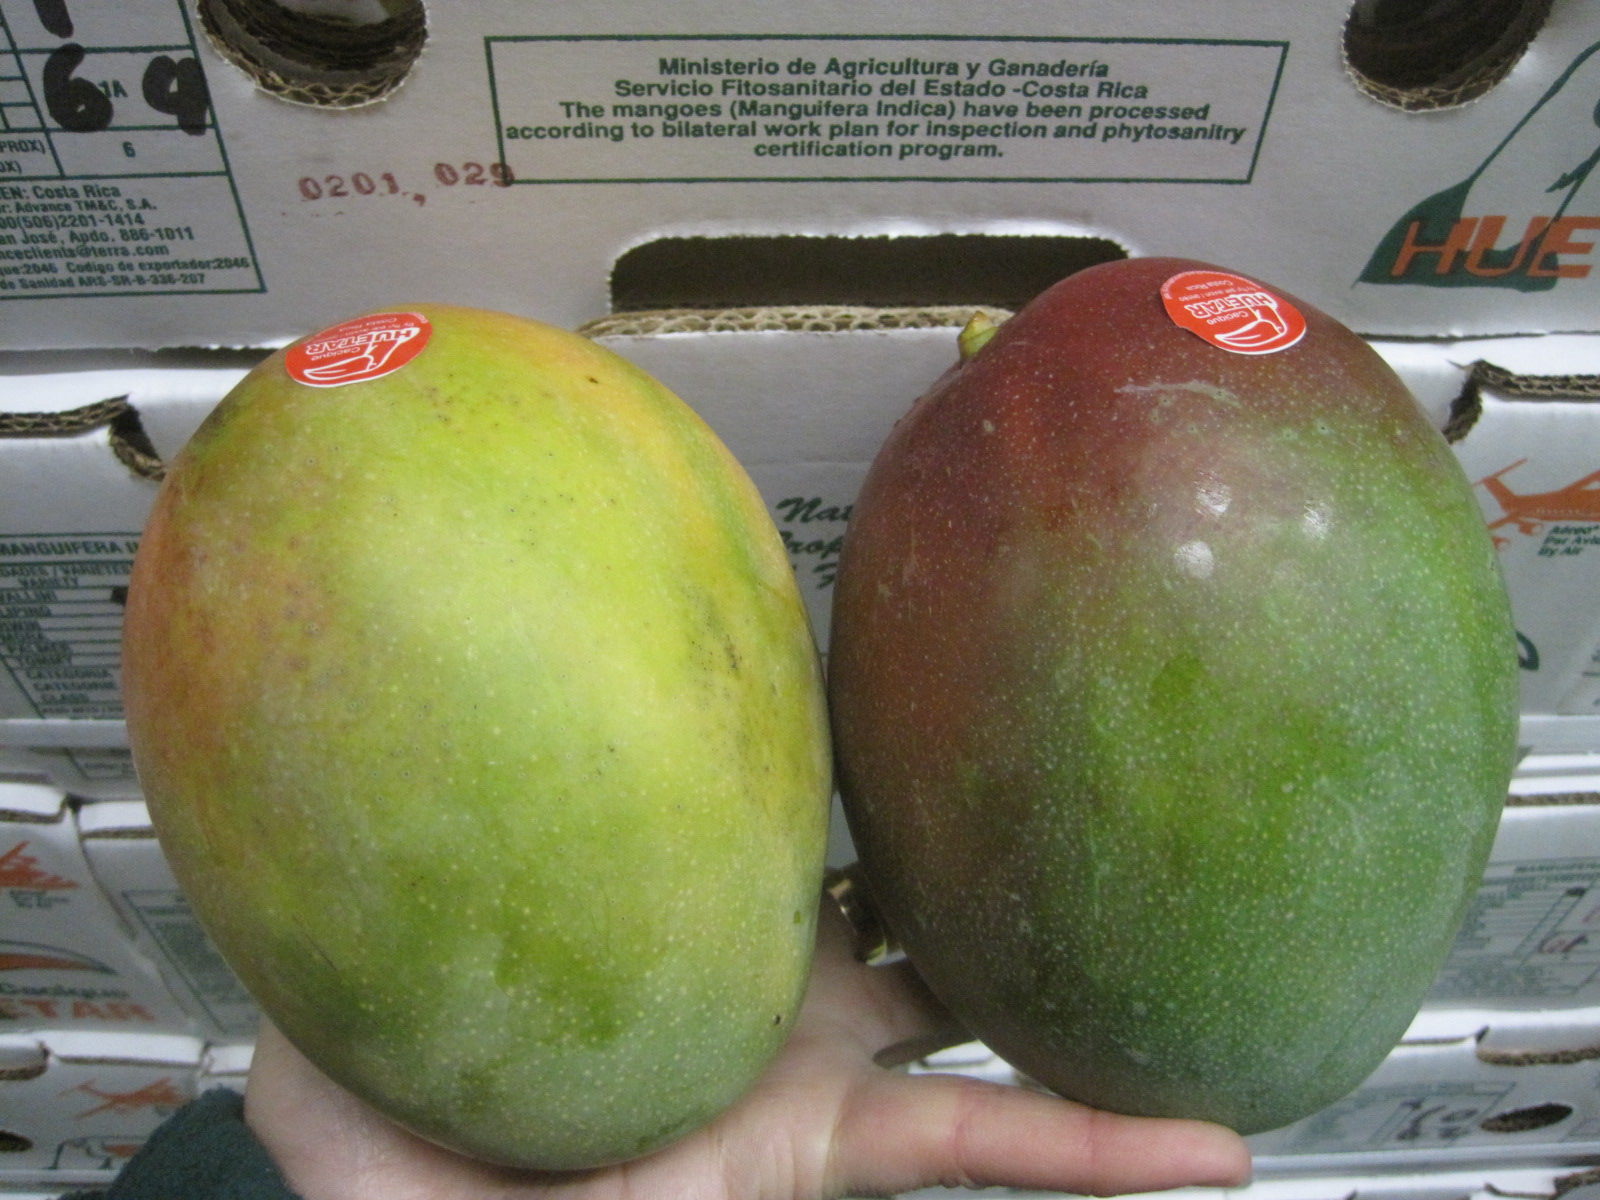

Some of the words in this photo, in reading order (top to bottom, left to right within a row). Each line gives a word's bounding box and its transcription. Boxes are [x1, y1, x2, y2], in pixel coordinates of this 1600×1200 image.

[659, 58, 779, 75] Ministerio
[787, 58, 816, 75] de
[824, 58, 959, 79] Agricultura
[967, 62, 981, 77] y
[989, 59, 1109, 77] Ganadería
[615, 80, 713, 97] Servicio
[722, 80, 872, 97] Fitosanitario
[880, 80, 915, 96] del
[924, 80, 1006, 97] Estado
[1097, 82, 1149, 99] Rica
[560, 101, 605, 118] The
[613, 105, 722, 122] mangoes
[729, 100, 869, 121] (Manguifera
[877, 101, 956, 121] Indica)
[963, 101, 1018, 118] have
[1026, 102, 1081, 118] been
[1089, 104, 1209, 122] processed
[506, 122, 624, 142] according
[631, 122, 654, 138] to
[662, 122, 757, 138] bilateral
[765, 121, 820, 137] work
[829, 122, 879, 141] plan
[886, 121, 917, 137] for
[926, 121, 1047, 142] inspection
[1053, 122, 1096, 138] and
[1102, 123, 1246, 145] phytosanitry
[754, 141, 892, 157] certification
[899, 143, 1003, 161] program.
[32, 186, 79, 200] Costa
[83, 184, 121, 198] Rica
[15, 202, 72, 213] Advance
[1184, 293, 1274, 319] HUETAR
[1206, 311, 1249, 325] Cacique
[305, 328, 414, 356] HUETAR
